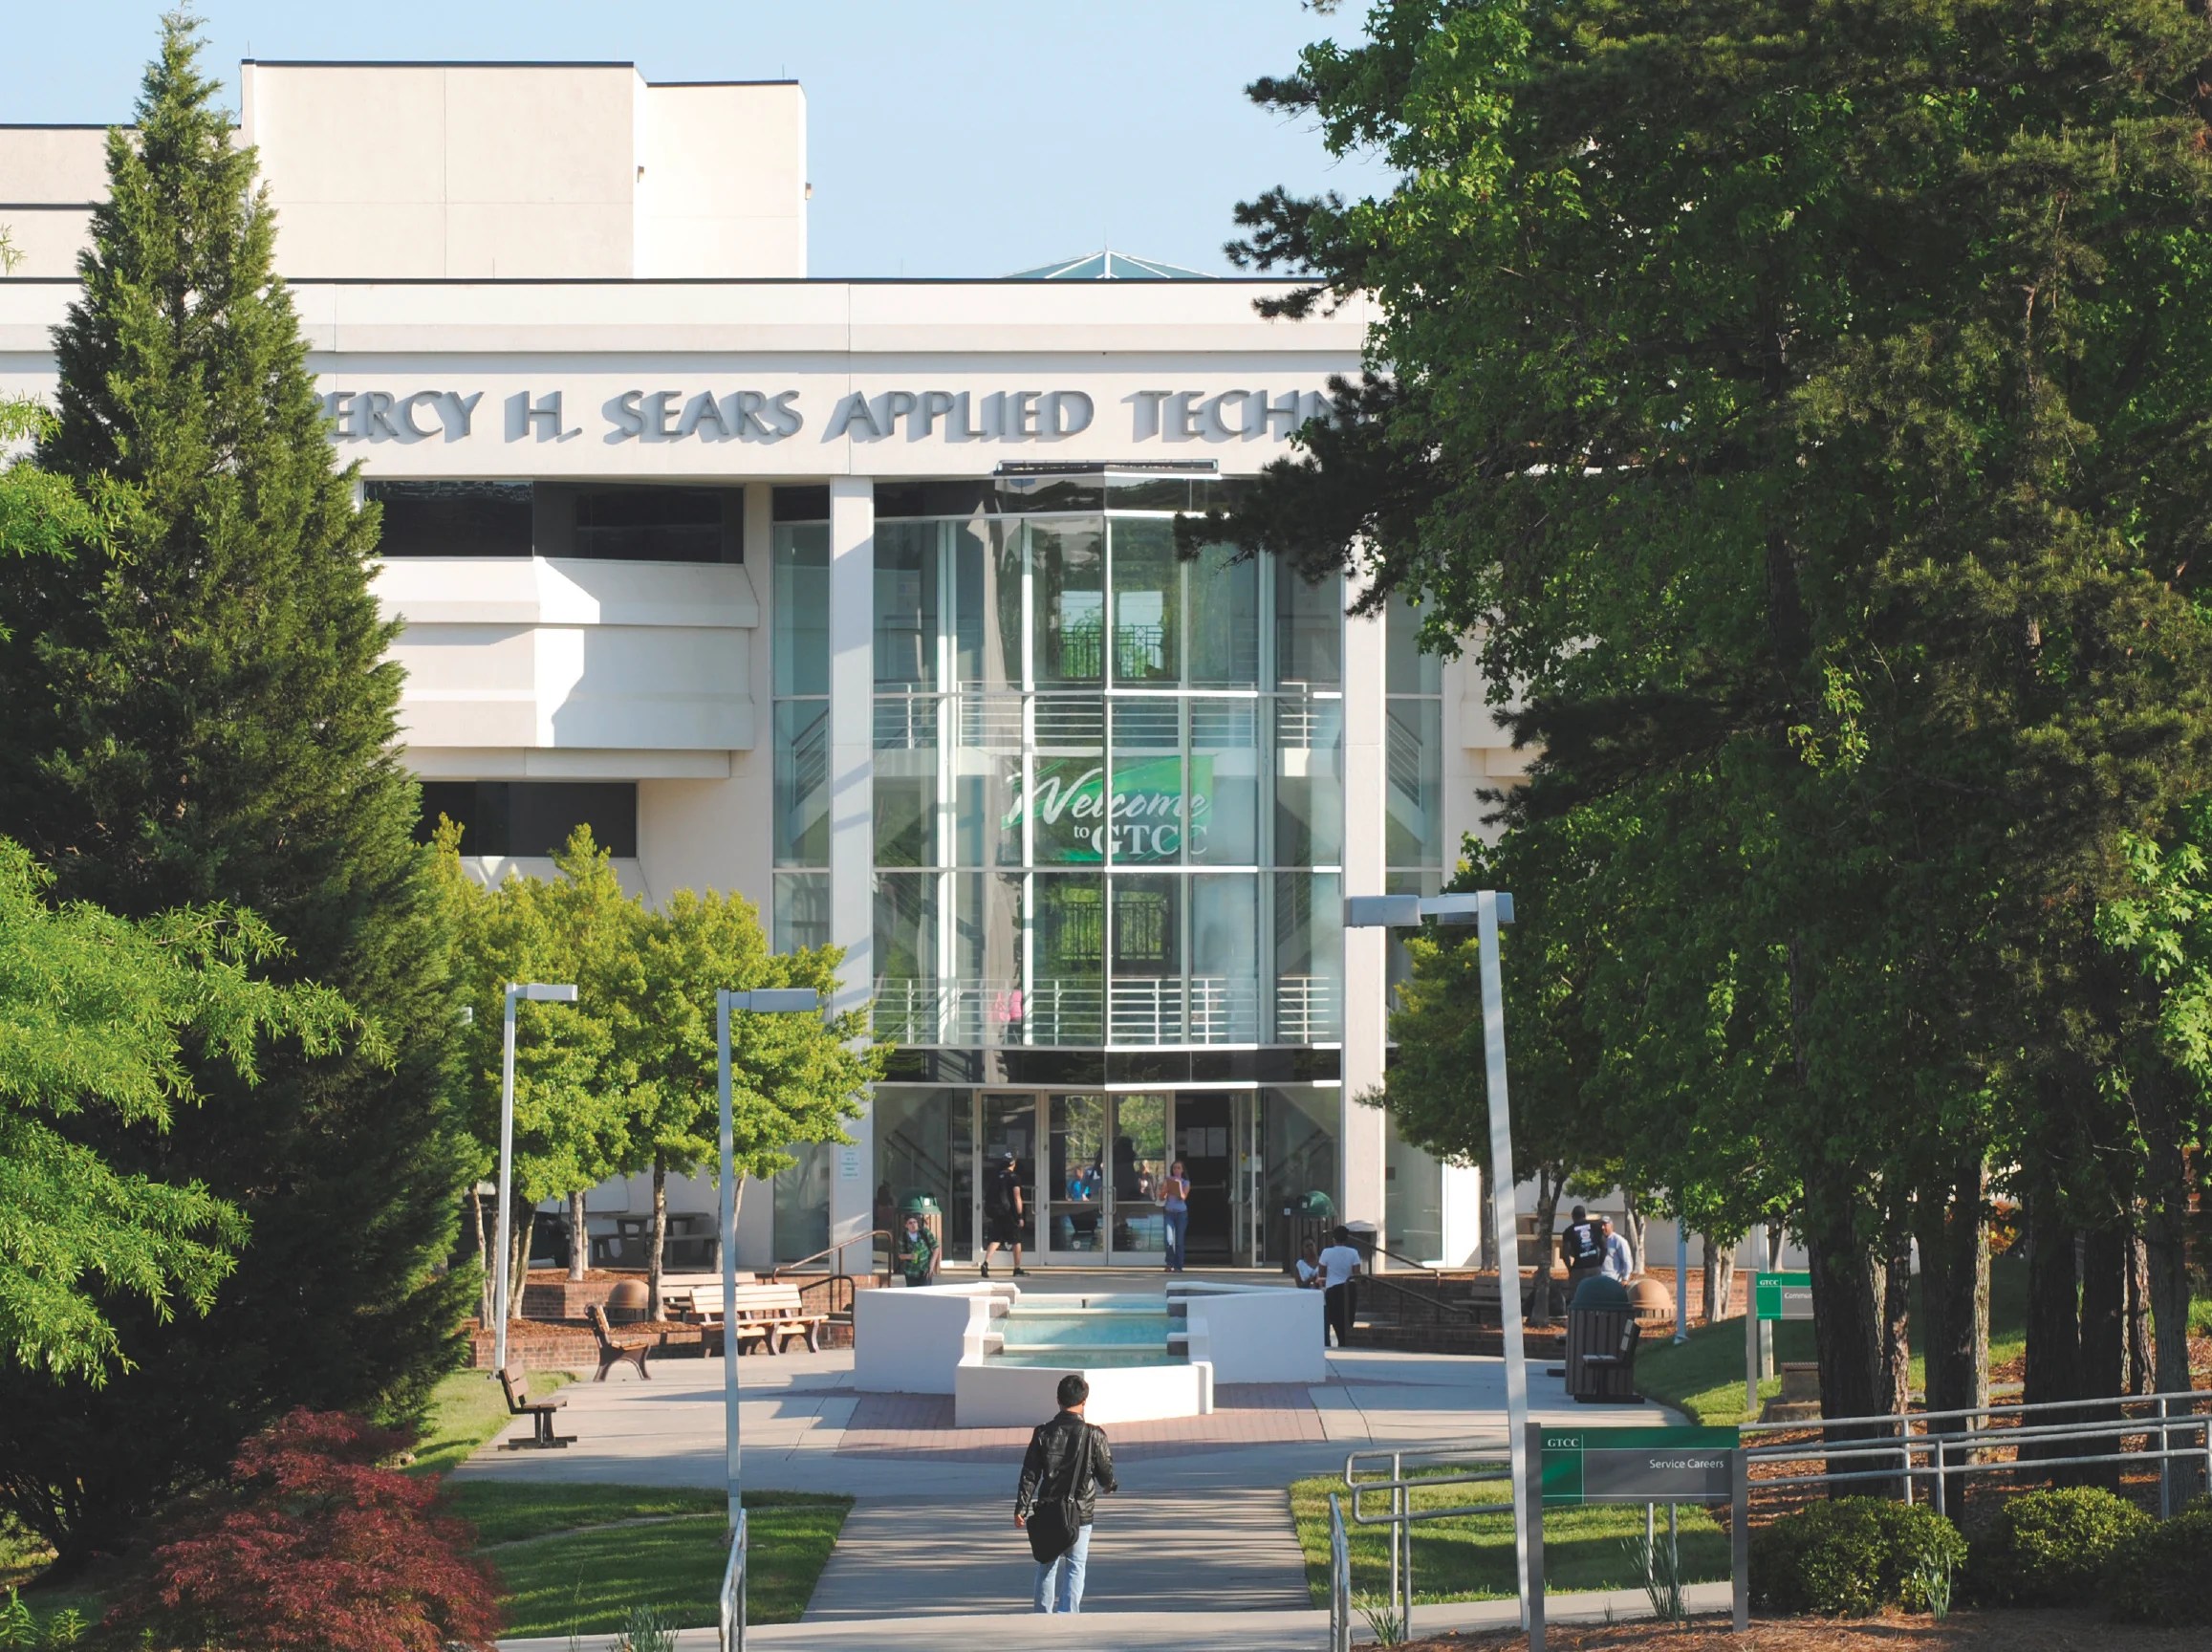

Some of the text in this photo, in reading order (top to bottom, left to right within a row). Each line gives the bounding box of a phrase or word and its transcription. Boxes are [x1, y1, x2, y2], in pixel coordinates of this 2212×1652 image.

[313, 390, 483, 437] ERCY
[523, 390, 583, 441] H.
[619, 389, 805, 437] SEARS
[839, 390, 1095, 436] APPLIED
[1073, 824, 1090, 838] to
[1547, 1438, 1579, 1448] GTCC
[1649, 1458, 1724, 1469] Service Careers
